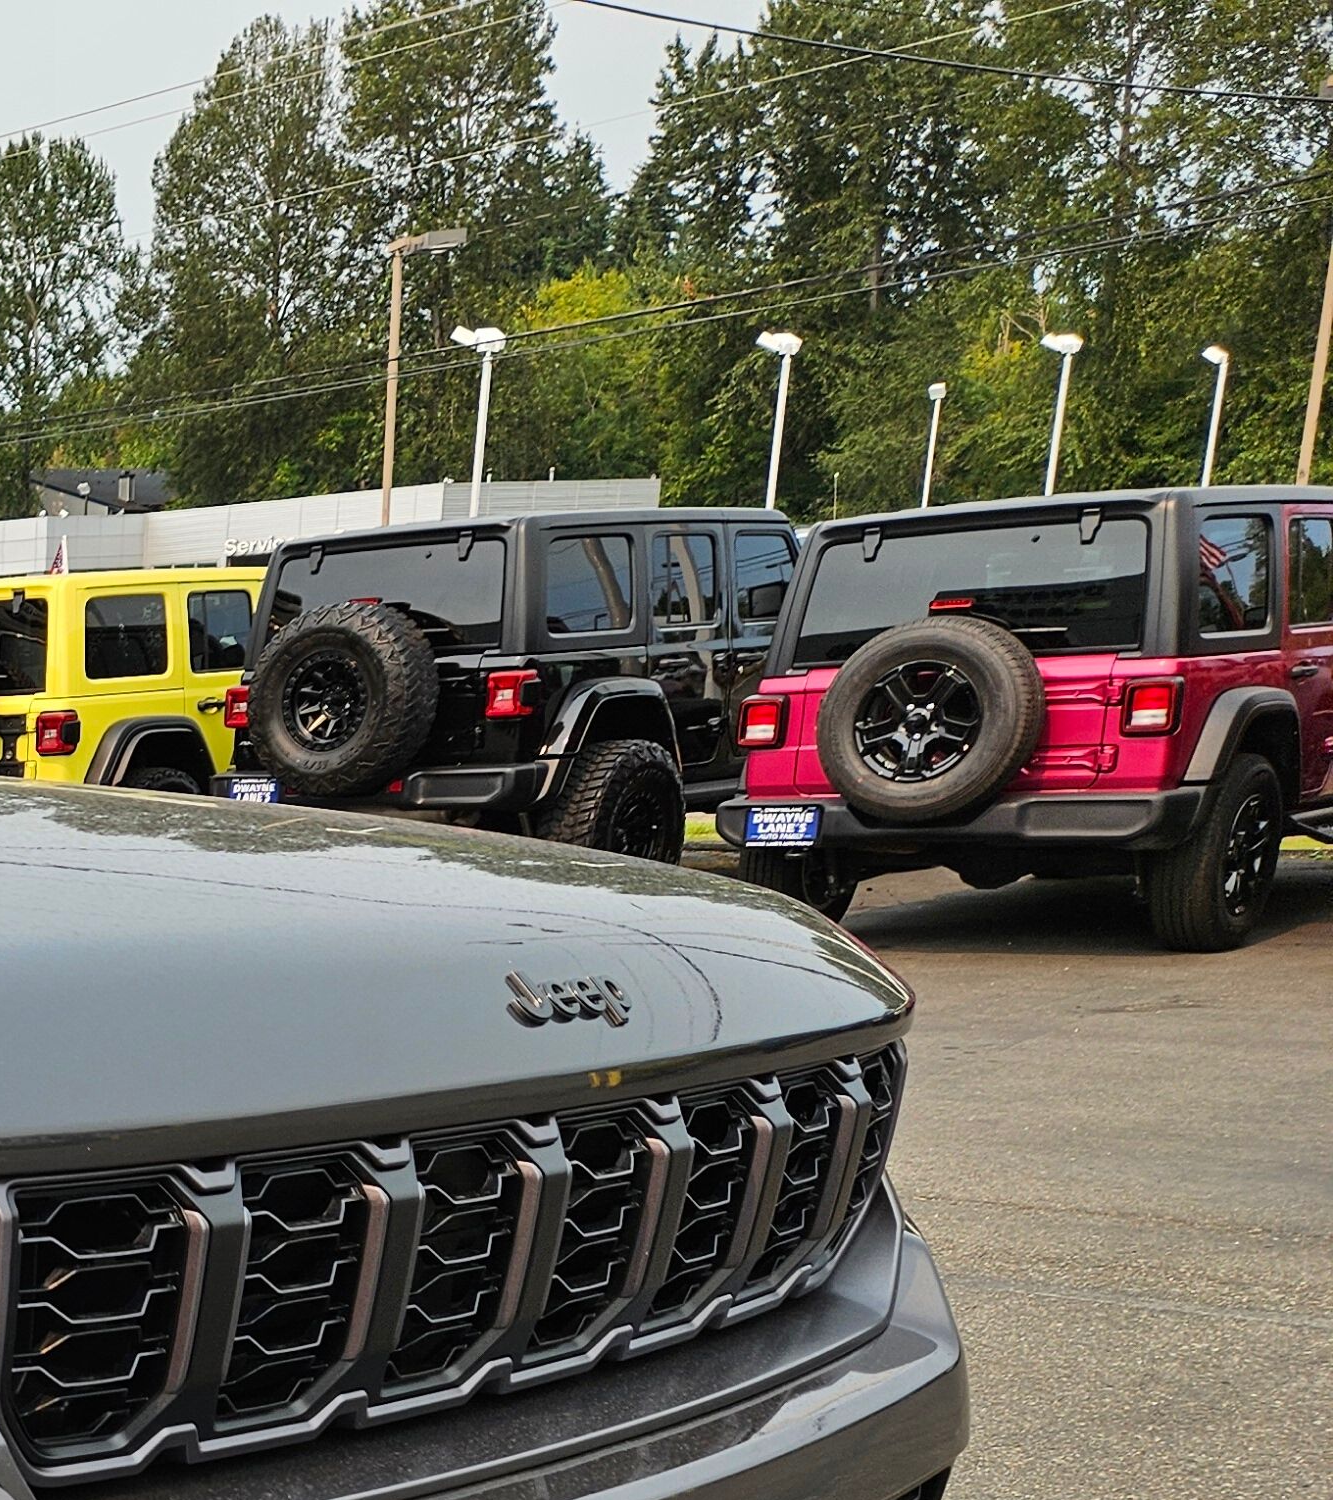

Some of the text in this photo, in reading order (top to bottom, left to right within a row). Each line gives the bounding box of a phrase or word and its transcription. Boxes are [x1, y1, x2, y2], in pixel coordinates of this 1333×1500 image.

[224, 536, 294, 556] Servic
[233, 783, 276, 793] DWAYNE
[753, 812, 815, 824] DWAYNE
[757, 823, 808, 833] LANE'S
[505, 970, 632, 1028] Jeep
